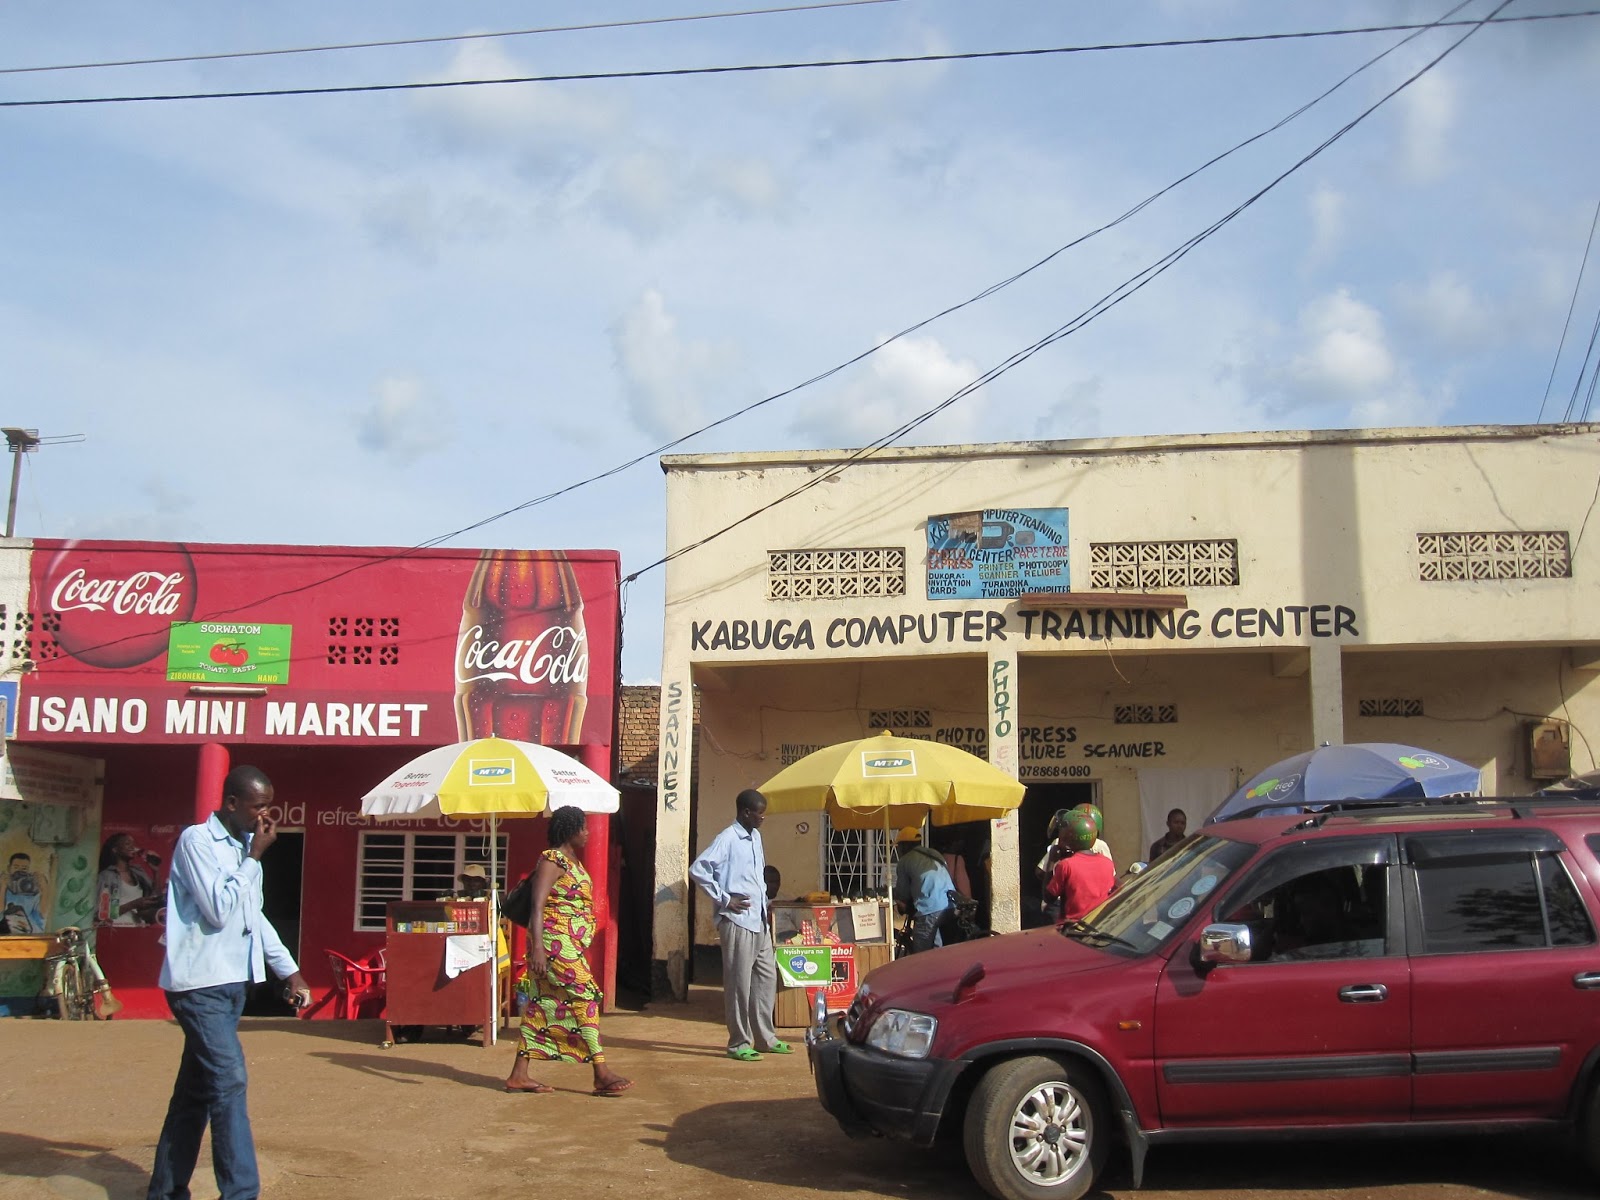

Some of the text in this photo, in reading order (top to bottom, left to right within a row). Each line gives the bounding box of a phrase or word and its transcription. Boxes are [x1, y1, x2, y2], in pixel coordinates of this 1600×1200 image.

[1019, 513, 1063, 545] TRAINING
[928, 545, 1068, 563] PHOTO CENTER PAPETERIE
[928, 558, 974, 570] EXPRESS
[979, 560, 1068, 571] PRINTER PHOTOCOPY
[978, 569, 1061, 579] SCANNER RELIURE
[51, 568, 185, 615] Coca-Cola
[1027, 585, 1070, 593] COMPUTER
[200, 624, 261, 634] SORWATOM
[691, 604, 1359, 650] KABUGA COMPUTER TRAINING CENTER
[455, 624, 588, 685] Coca-Cola
[199, 662, 257, 674] TOMATO PASTE
[170, 672, 278, 683] ZIBONEKA HANO
[992, 660, 1011, 737] PHOTO
[28, 696, 428, 737] ISANO MINI MARKET
[935, 727, 986, 743] PHOTO
[1020, 726, 1077, 743] PRESS
[663, 681, 683, 813] SCANNER
[1020, 744, 1066, 759] LIURE
[1083, 741, 1166, 758] SCANNER
[874, 759, 904, 767] MTN
[404, 771, 432, 780] Better
[479, 767, 507, 775] MTN
[552, 769, 578, 777] Better
[390, 779, 429, 789] Together
[553, 776, 592, 785] Together
[268, 801, 306, 825] old
[317, 806, 426, 827] refresen
[783, 948, 815, 956] Nyishyura
[831, 946, 853, 955] aho!
[791, 960, 803, 968] tigo
